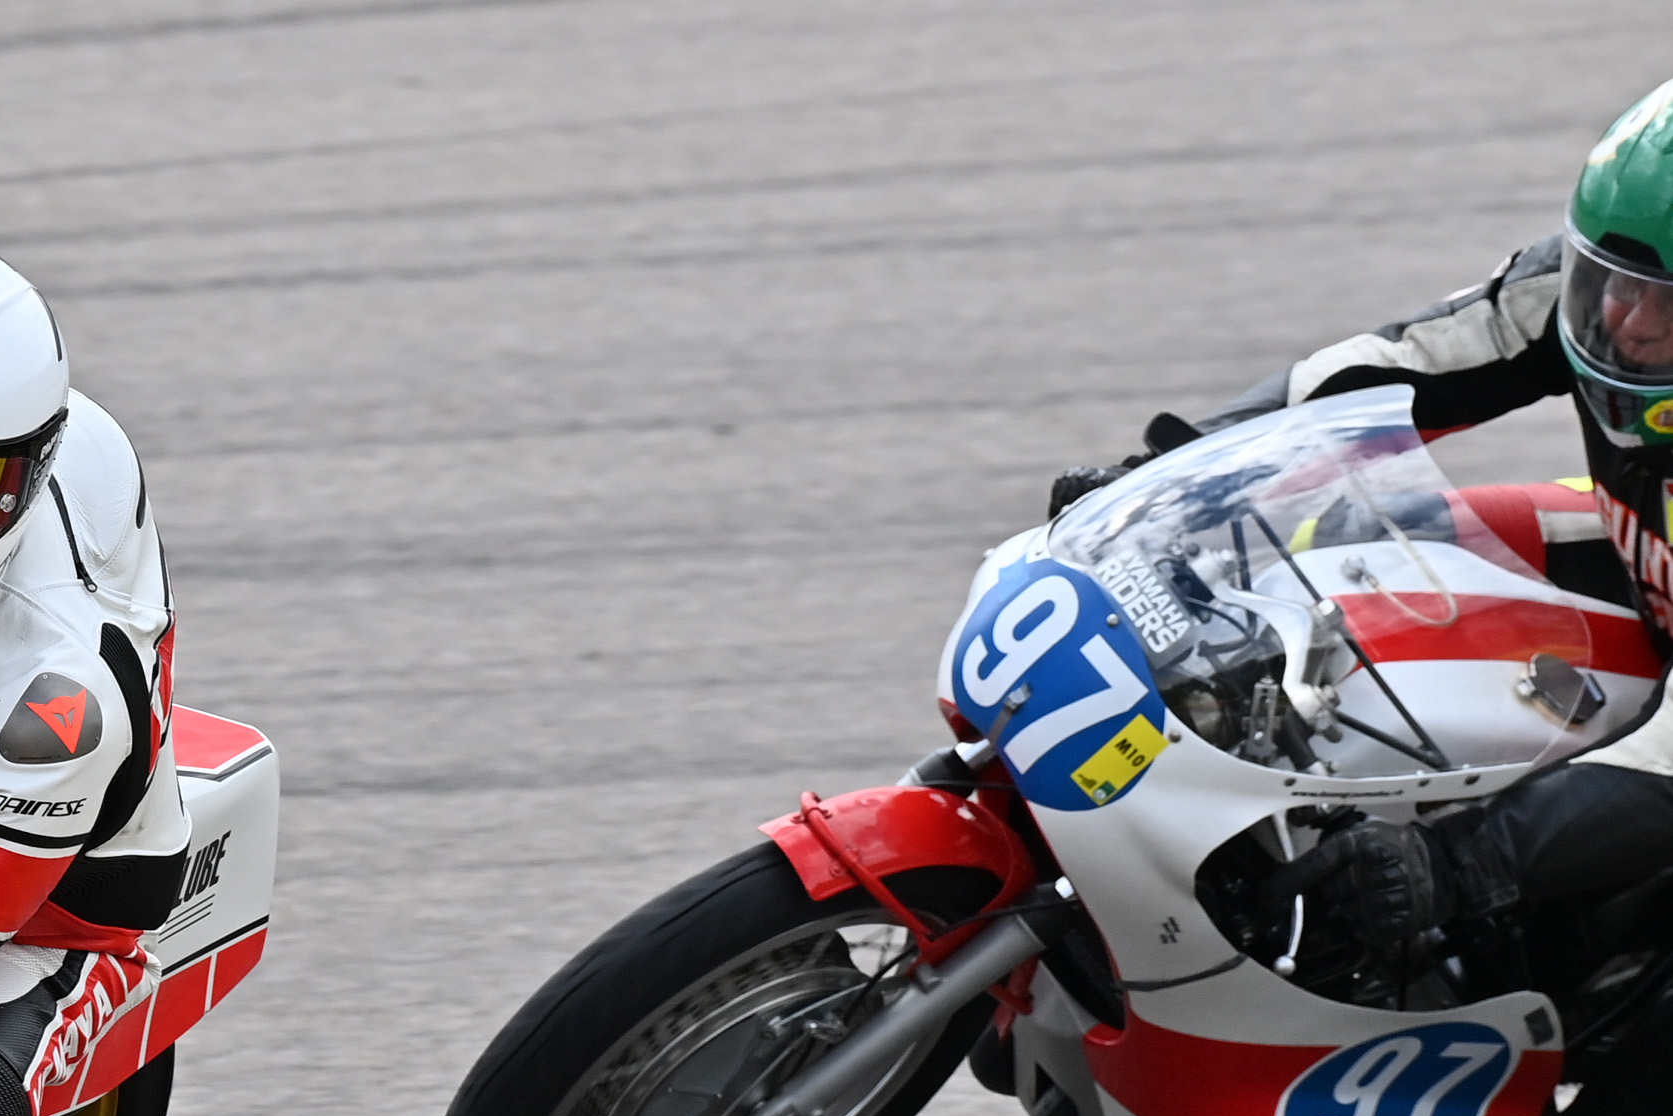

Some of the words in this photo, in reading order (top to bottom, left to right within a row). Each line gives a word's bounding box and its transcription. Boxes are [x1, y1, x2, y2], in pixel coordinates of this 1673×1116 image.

[1096, 557, 1176, 654] RIDERS
[962, 575, 1150, 776] 97
[1114, 738, 1145, 768] M10
